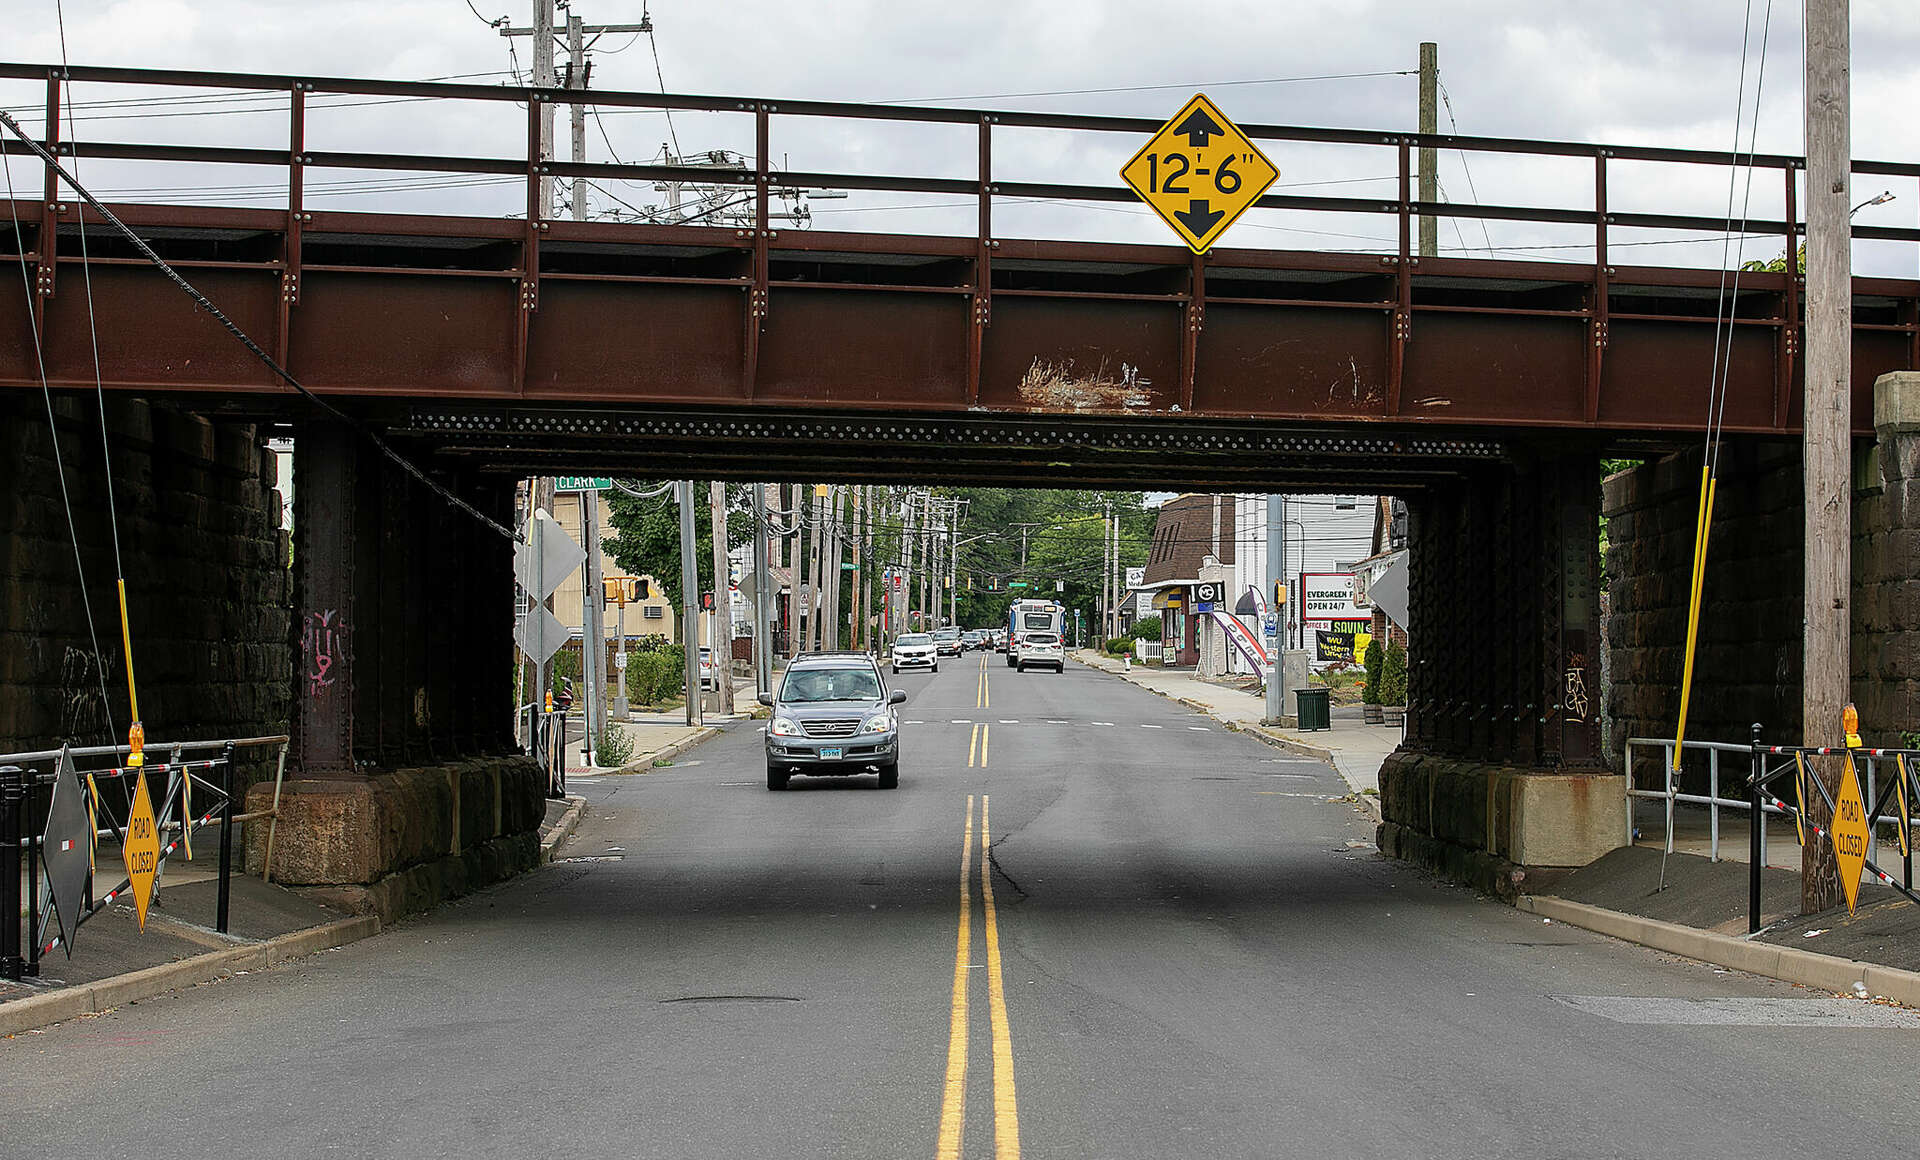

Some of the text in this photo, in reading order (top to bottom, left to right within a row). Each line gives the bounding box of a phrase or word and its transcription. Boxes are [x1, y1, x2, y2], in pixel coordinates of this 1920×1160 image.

[1146, 152, 1254, 194] 12'-6"
[559, 476, 596, 489] CLARK
[1307, 590, 1347, 598] EVERGREEN
[1307, 602, 1345, 611] OPEN 24/7
[1841, 799, 1859, 823] ROAD
[133, 816, 151, 840] ROAD
[1838, 832, 1863, 858] CLOSED
[131, 851, 153, 874] CLOSED
